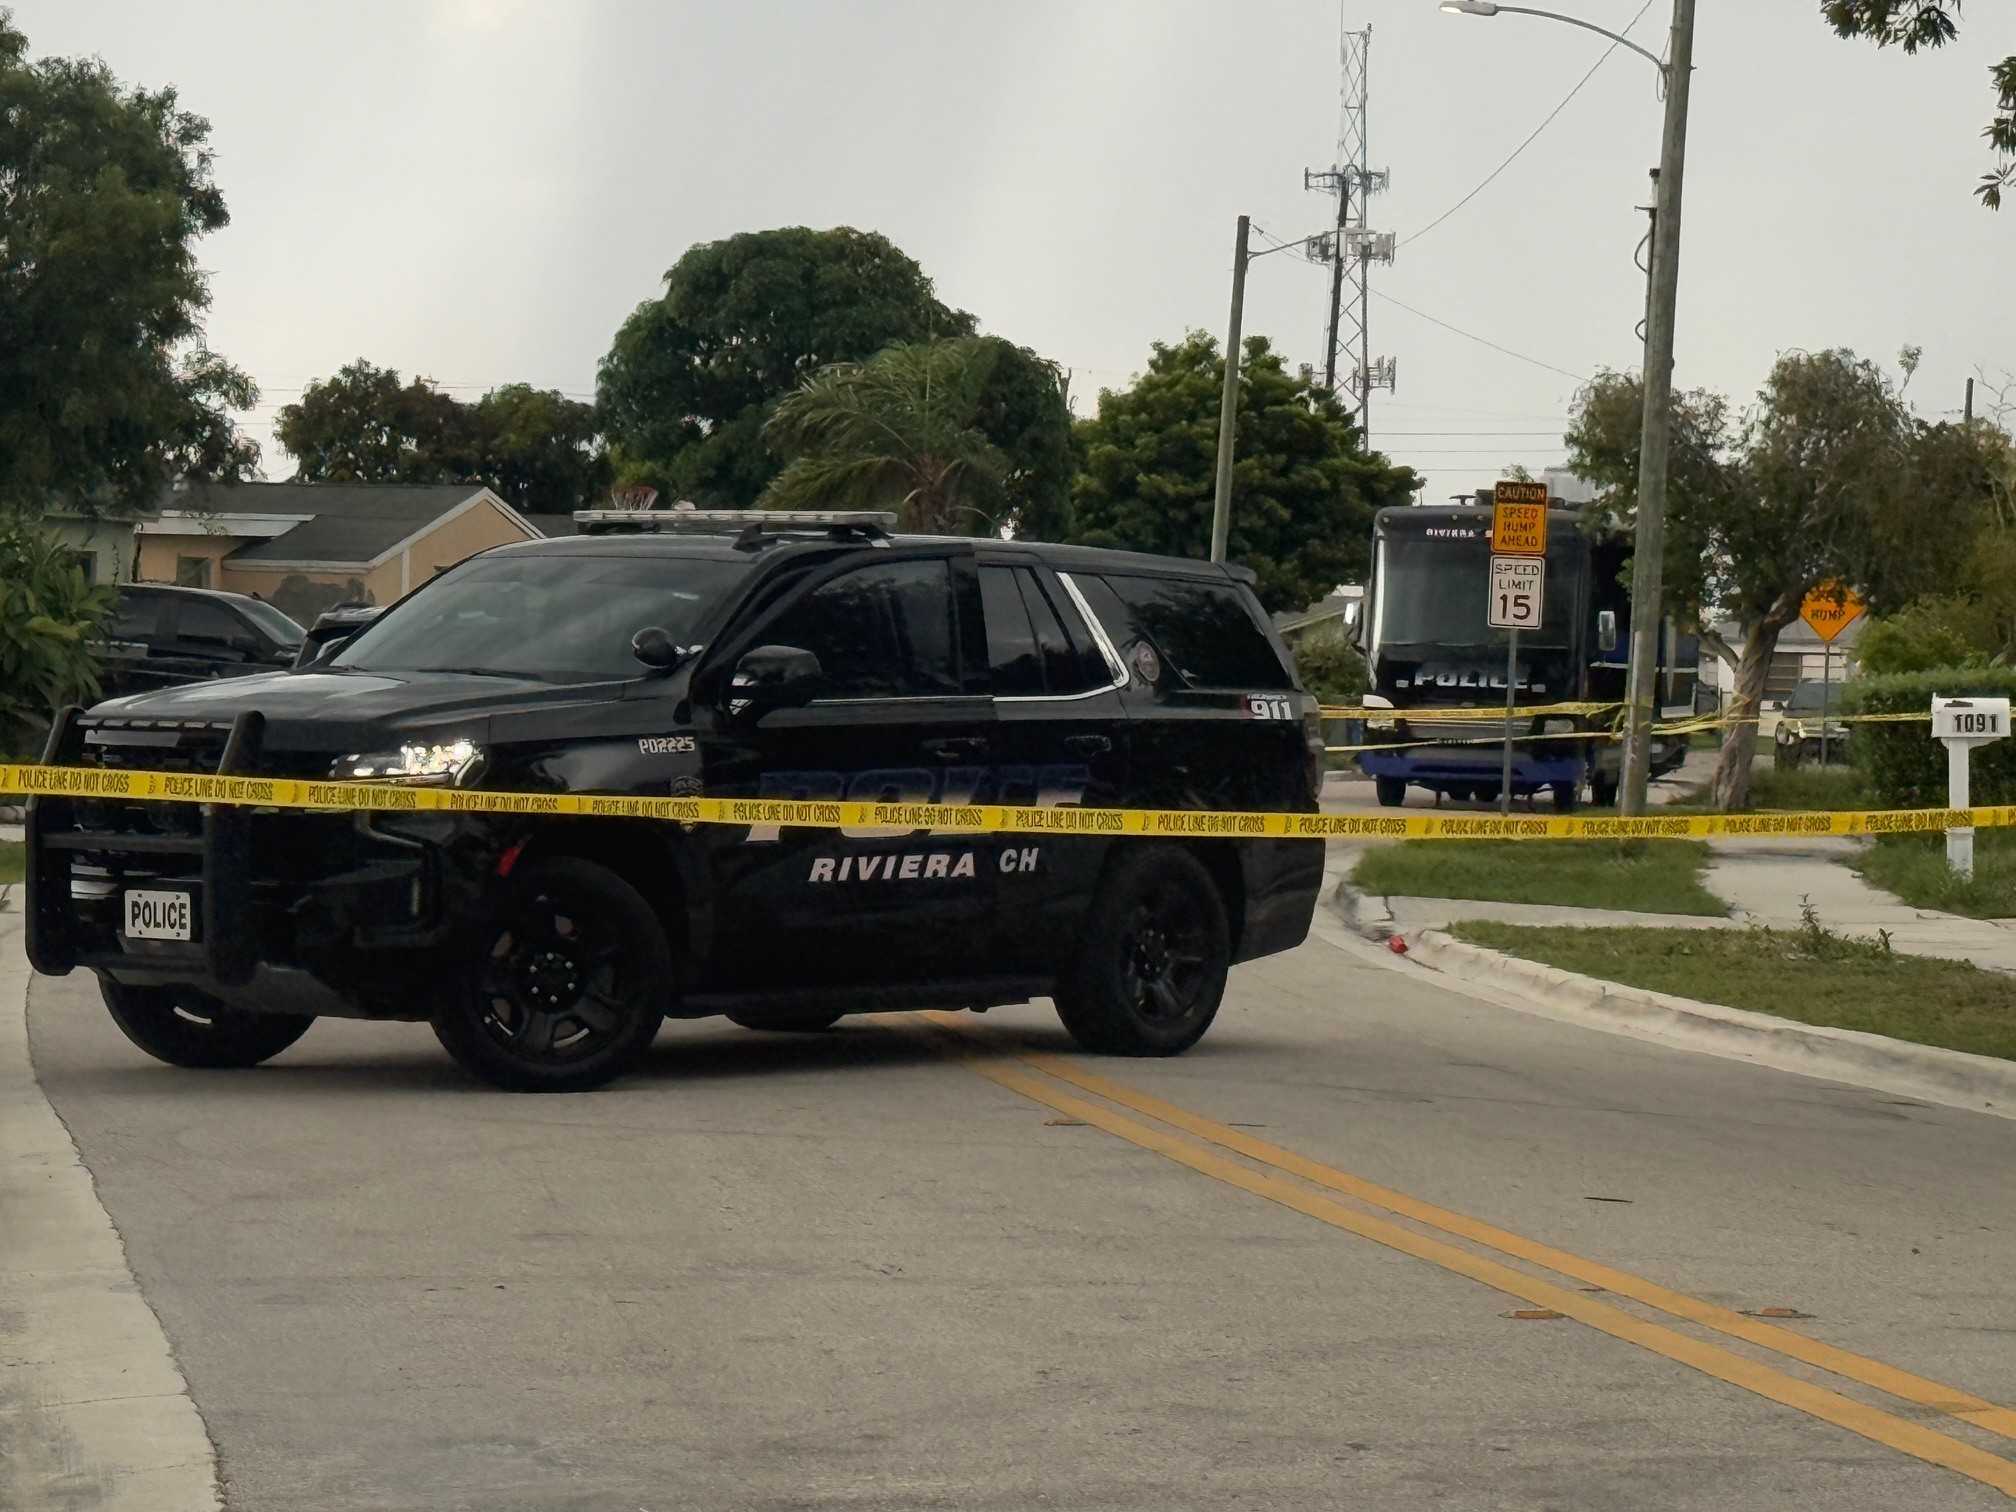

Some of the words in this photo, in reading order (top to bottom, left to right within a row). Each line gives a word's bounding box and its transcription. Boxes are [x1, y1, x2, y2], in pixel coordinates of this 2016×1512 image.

[1497, 486, 1546, 500] CAUTION
[1502, 507, 1539, 519] SPEED
[1503, 521, 1536, 533] HUMP
[1500, 535, 1538, 547] AHEAD
[1495, 563, 1540, 576] SPEED
[1498, 579, 1534, 592] LIMIT
[1499, 593, 1532, 620] 15
[1810, 606, 1846, 621] HUMP
[1250, 701, 1292, 720] 911
[1953, 713, 1999, 733] 1091
[18, 768, 46, 789] POLICE
[50, 770, 67, 790] LINE
[69, 771, 81, 791] DO
[84, 772, 99, 791] NOT
[102, 773, 130, 793] CROSS
[164, 776, 193, 797] POLICE
[195, 778, 213, 798] LINE
[215, 778, 226, 799] DO
[229, 780, 244, 800] NOT
[246, 782, 273, 801] CROSS
[308, 785, 336, 805] POLICE
[338, 787, 357, 806] LINE
[358, 788, 369, 807] DO
[371, 788, 388, 808] NOT
[389, 790, 416, 809] CROSS
[450, 792, 479, 809] POLICE
[481, 794, 497, 809] LINE
[500, 796, 511, 810] DO
[513, 797, 530, 810] NOT
[532, 797, 558, 811] CROSS
[592, 800, 619, 816] POLICE
[622, 801, 639, 817] LINE
[642, 802, 653, 817] DO
[655, 802, 670, 817] NOT
[672, 801, 699, 818] CROSS
[734, 803, 762, 821] POLICE
[764, 804, 781, 821] LINE
[783, 804, 794, 821] DO
[796, 804, 811, 821] NOT
[814, 804, 841, 823] CROSS
[874, 806, 902, 824] POLICE
[904, 807, 923, 824] LINE
[924, 807, 936, 824] DO
[937, 807, 953, 825] NOT
[955, 808, 982, 826] CROSS
[1016, 809, 1044, 828] POLICE
[1046, 810, 1064, 829] LINE
[1066, 811, 1077, 829] DO
[1079, 812, 1095, 829] NOT
[1096, 812, 1123, 831] CROSS
[1157, 813, 1186, 832] POLICE
[1188, 814, 1206, 832] LINE
[1208, 815, 1219, 832] DO
[1221, 815, 1237, 832] NOT
[1239, 815, 1265, 833] CROSS
[1299, 816, 1328, 834] POLICE
[1329, 817, 1346, 834] LINE
[1349, 818, 1360, 834] DO
[1362, 818, 1377, 834] NOT
[1379, 818, 1406, 834] CROSS
[1440, 819, 1469, 834] POLICE
[1470, 820, 1487, 835] LINE
[1489, 820, 1500, 835] DO
[1502, 820, 1519, 835] NOT
[1520, 820, 1549, 835] CROSS
[1724, 818, 1751, 833] POLICE
[1753, 818, 1772, 833] LINE
[1773, 817, 1785, 832] DO
[1786, 816, 1802, 832] NOT
[1804, 815, 1831, 832] CROSS
[807, 851, 976, 883] RIVIERA
[131, 900, 188, 930] POLICE
